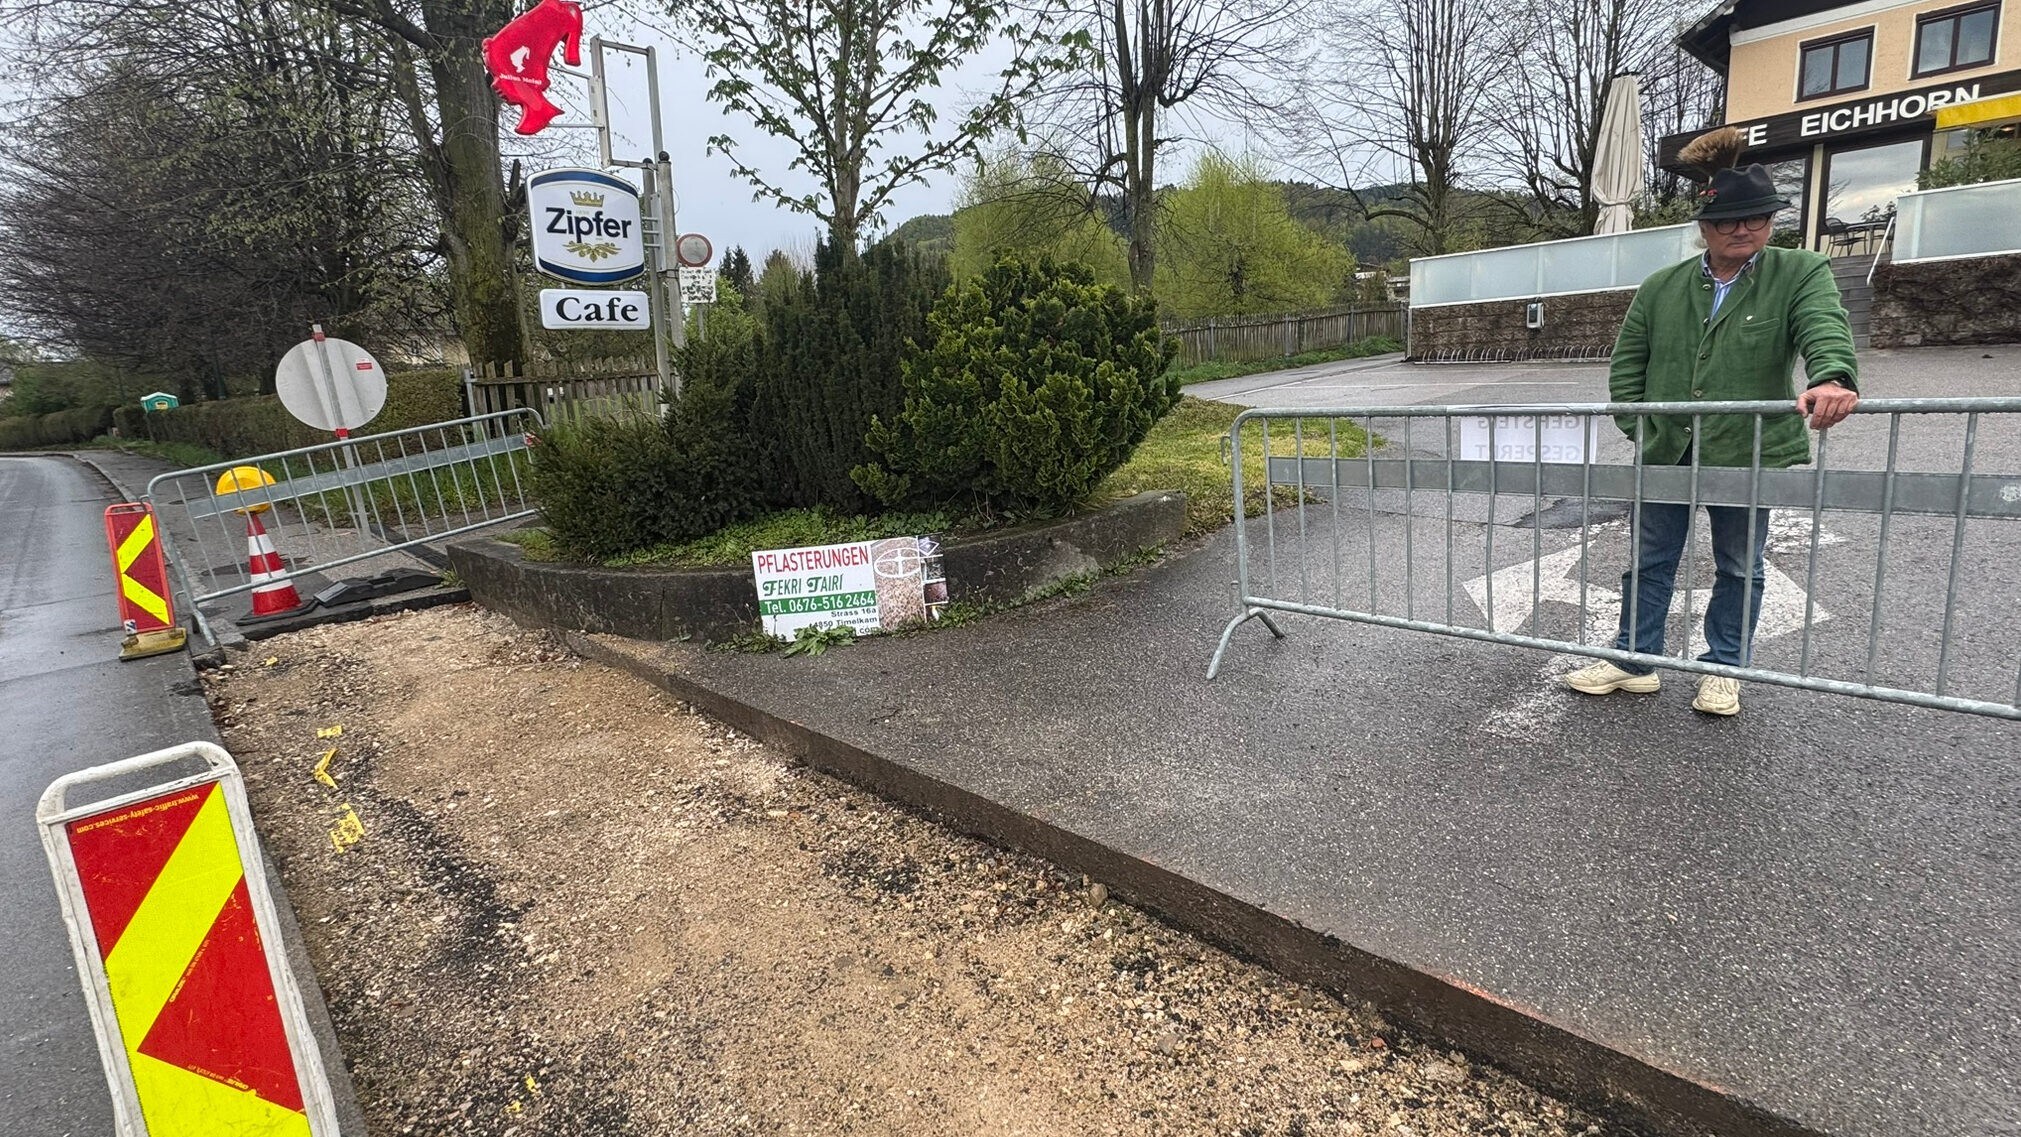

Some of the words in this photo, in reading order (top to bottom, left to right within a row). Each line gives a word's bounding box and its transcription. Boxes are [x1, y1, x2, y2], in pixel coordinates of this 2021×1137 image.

[1801, 84, 1980, 137] EICHHORN
[545, 207, 632, 243] Zipfer
[556, 297, 639, 322] Cafe
[757, 545, 869, 574] PFLASTERUNGEN
[762, 578, 801, 597] FEKRI
[765, 601, 787, 614] Tel.
[789, 596, 843, 612] 0676-516
[845, 592, 875, 608] 2464
[76, 794, 199, 834] www.traffic-safety-services.com
